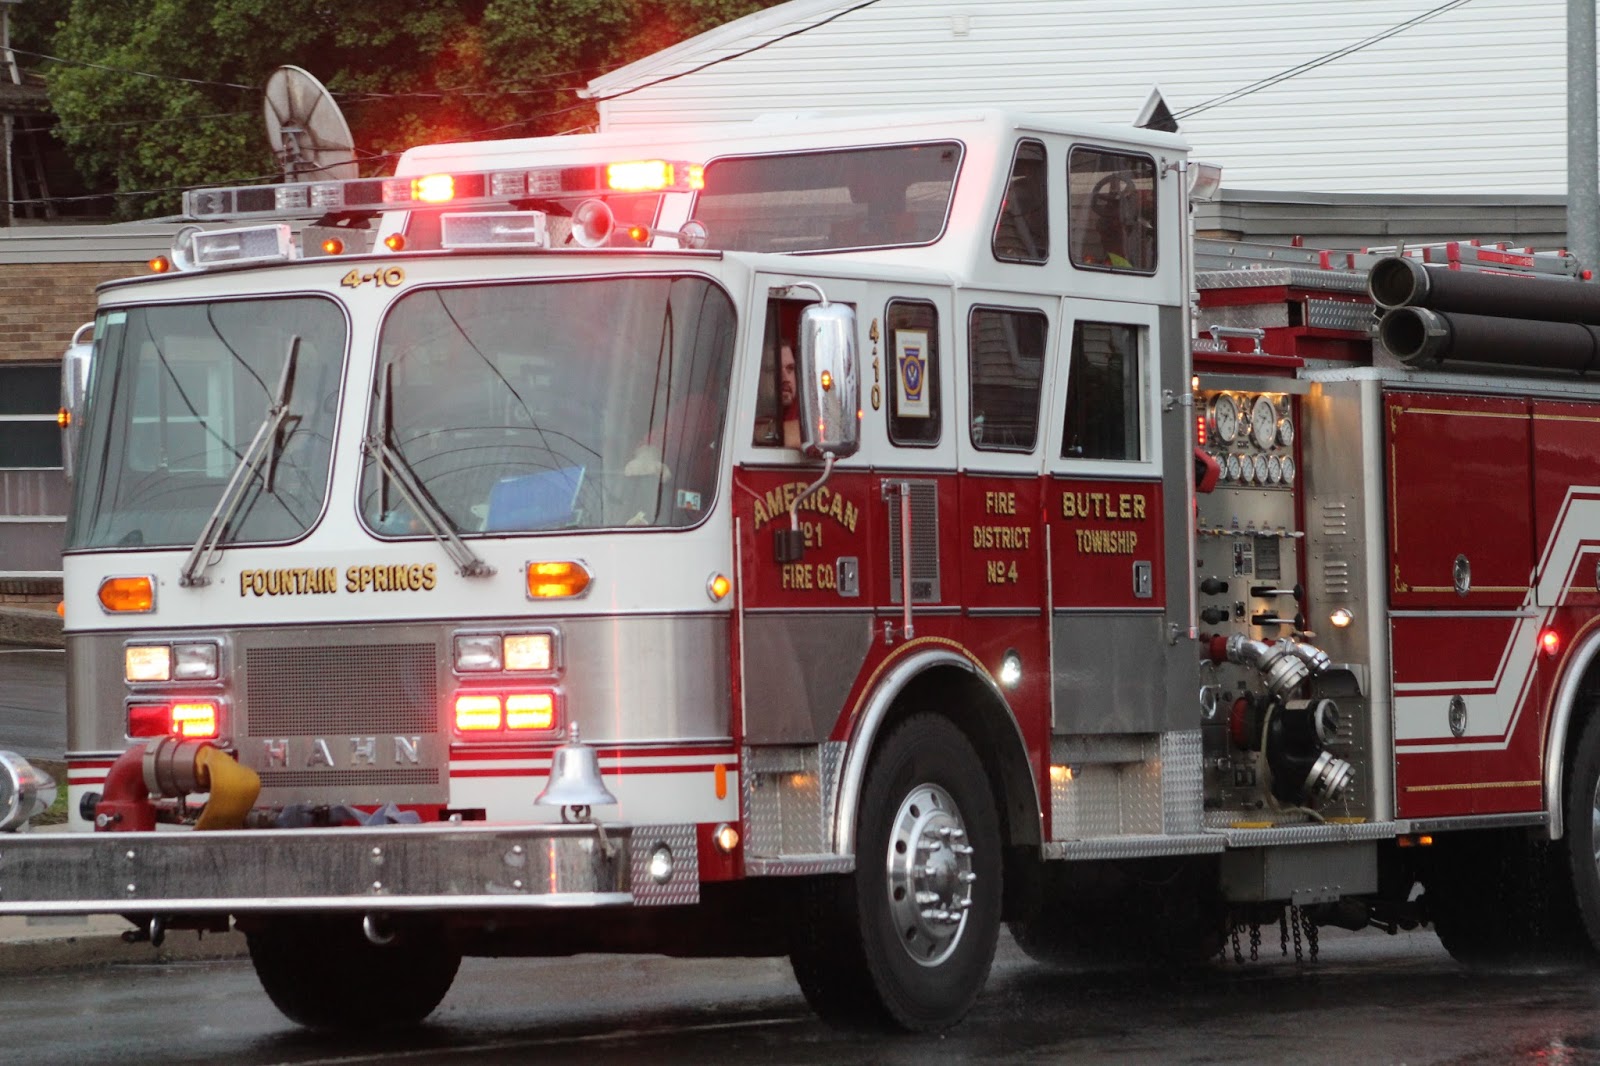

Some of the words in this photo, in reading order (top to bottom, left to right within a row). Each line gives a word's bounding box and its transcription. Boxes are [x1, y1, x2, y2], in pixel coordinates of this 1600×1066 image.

[341, 266, 405, 288] 4-10
[754, 482, 858, 533] AMERICAN
[986, 491, 1016, 514] FIRE
[1063, 491, 1146, 519] BUTLER
[973, 525, 1031, 549] DISTRICT
[1076, 529, 1138, 554] TOWNSHIP
[240, 567, 337, 597] FOUNTAIN
[345, 562, 437, 592] SPRINGS
[783, 564, 813, 589] FIRE
[264, 736, 421, 768] HAHN
